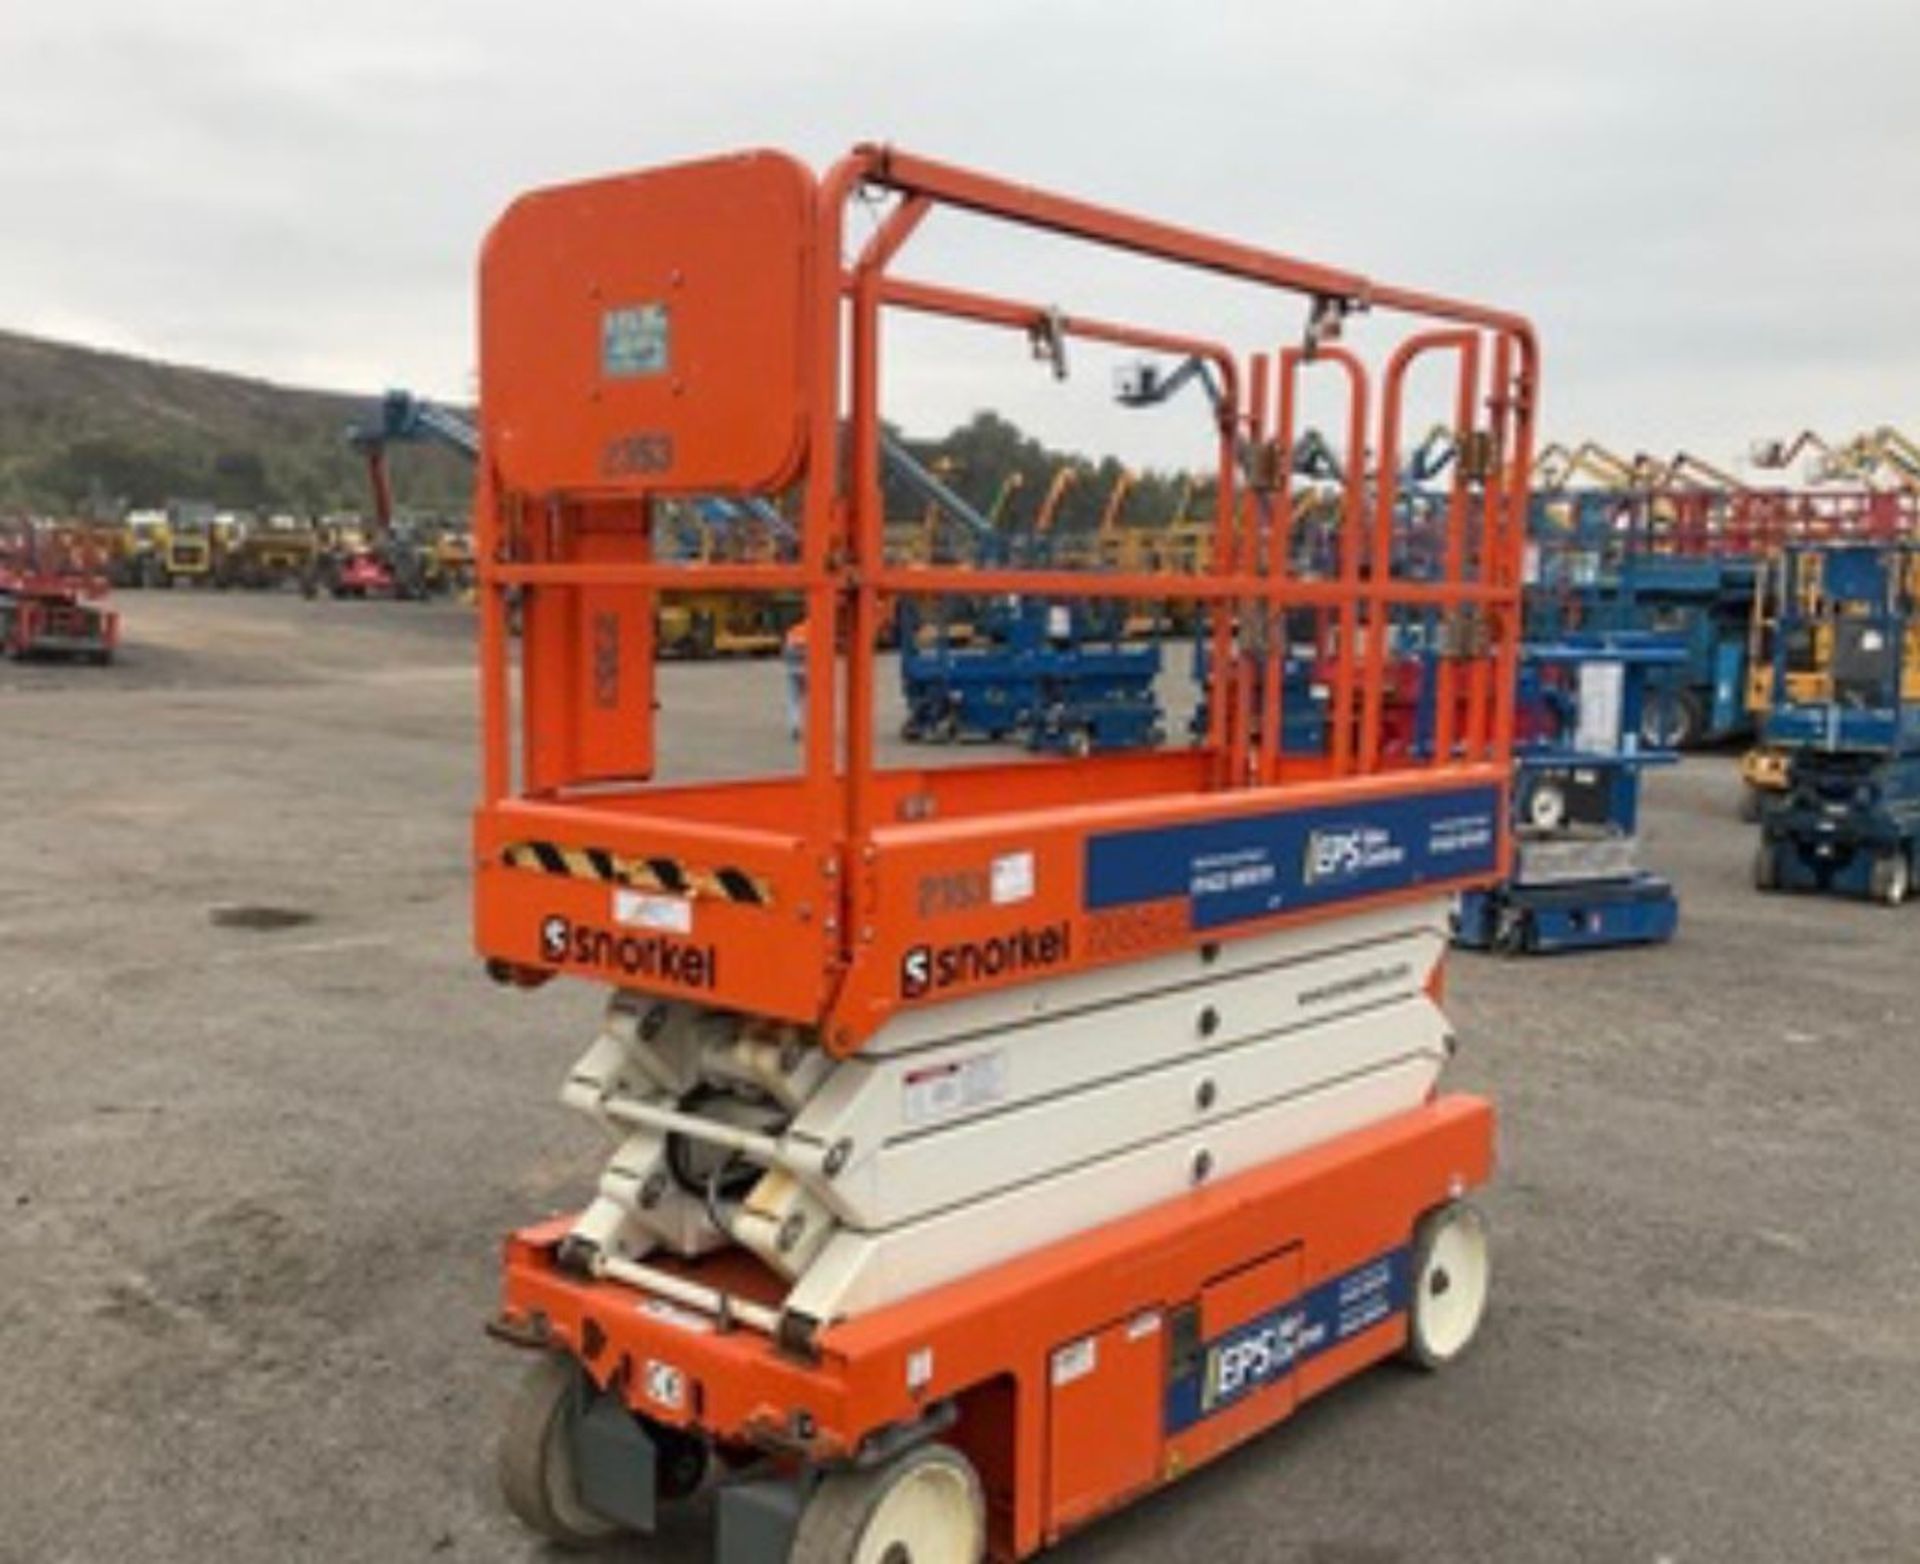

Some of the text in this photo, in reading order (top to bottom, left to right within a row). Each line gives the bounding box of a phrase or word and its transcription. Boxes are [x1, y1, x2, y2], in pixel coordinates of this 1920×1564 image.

[1314, 829, 1362, 875] EPS
[574, 923, 715, 986] snorkel
[936, 920, 1071, 988] snorkel
[1218, 1326, 1296, 1396] EPS
